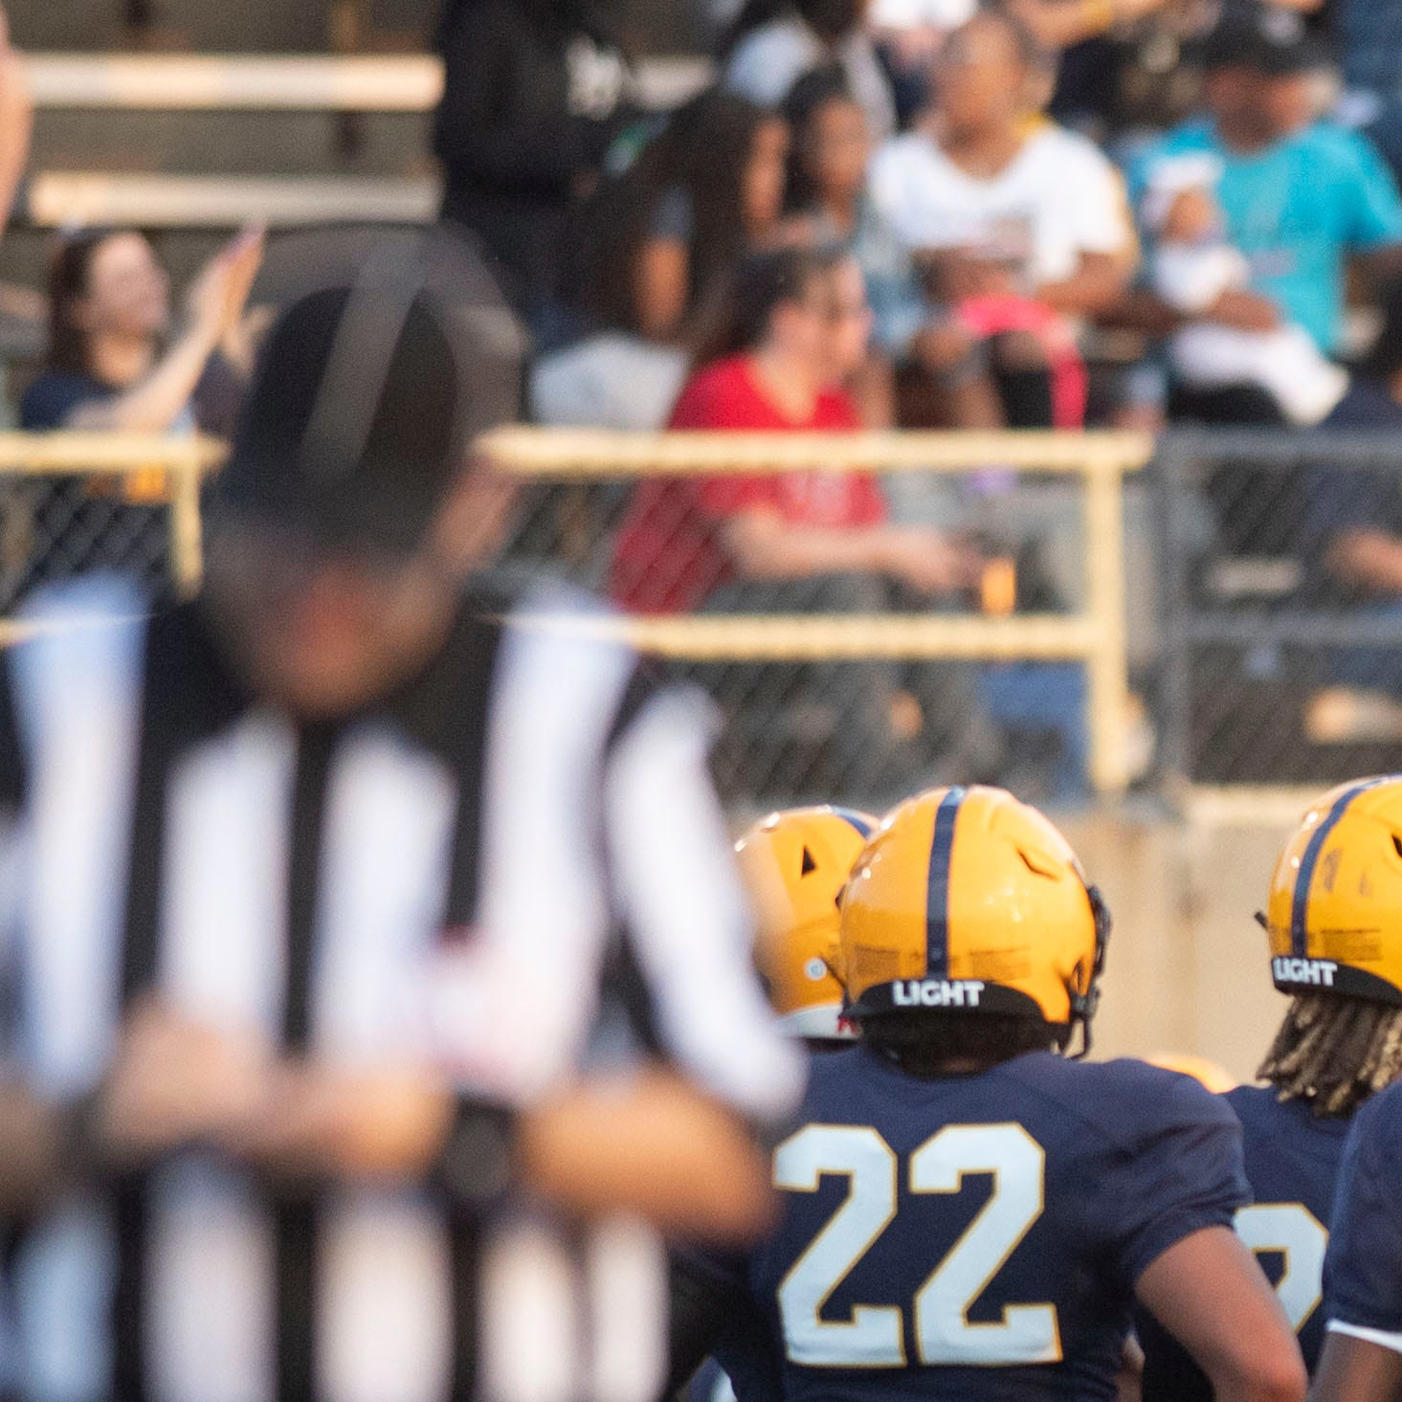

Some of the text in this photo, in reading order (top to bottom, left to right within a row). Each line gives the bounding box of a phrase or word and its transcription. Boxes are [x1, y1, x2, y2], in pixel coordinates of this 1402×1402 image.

[1272, 956, 1338, 987] LIGHT
[892, 980, 985, 1007] LIGHT
[771, 1121, 1064, 1368] 22
